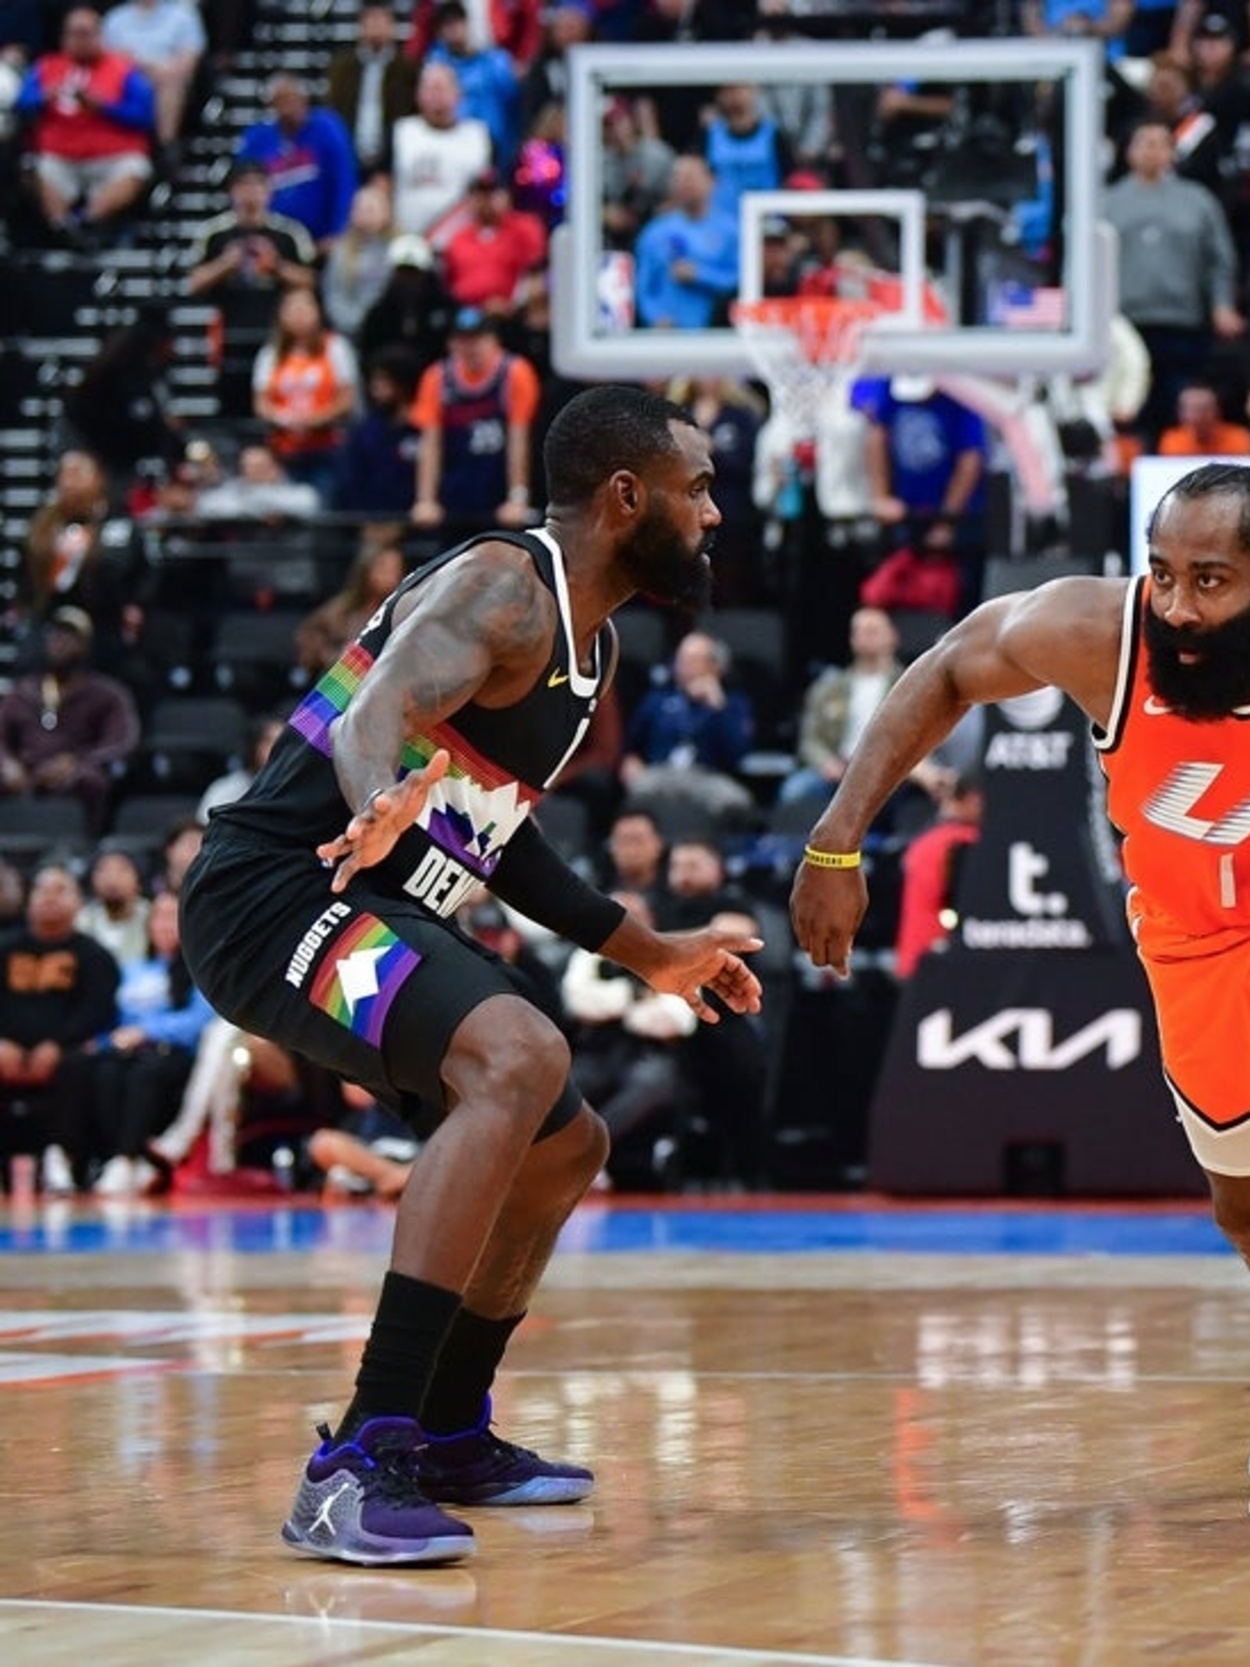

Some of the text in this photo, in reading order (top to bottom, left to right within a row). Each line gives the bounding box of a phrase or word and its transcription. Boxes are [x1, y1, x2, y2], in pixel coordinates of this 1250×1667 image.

[984, 731, 1074, 771] AT&T
[1219, 852, 1238, 909] 1
[284, 900, 353, 989] NUGGETS
